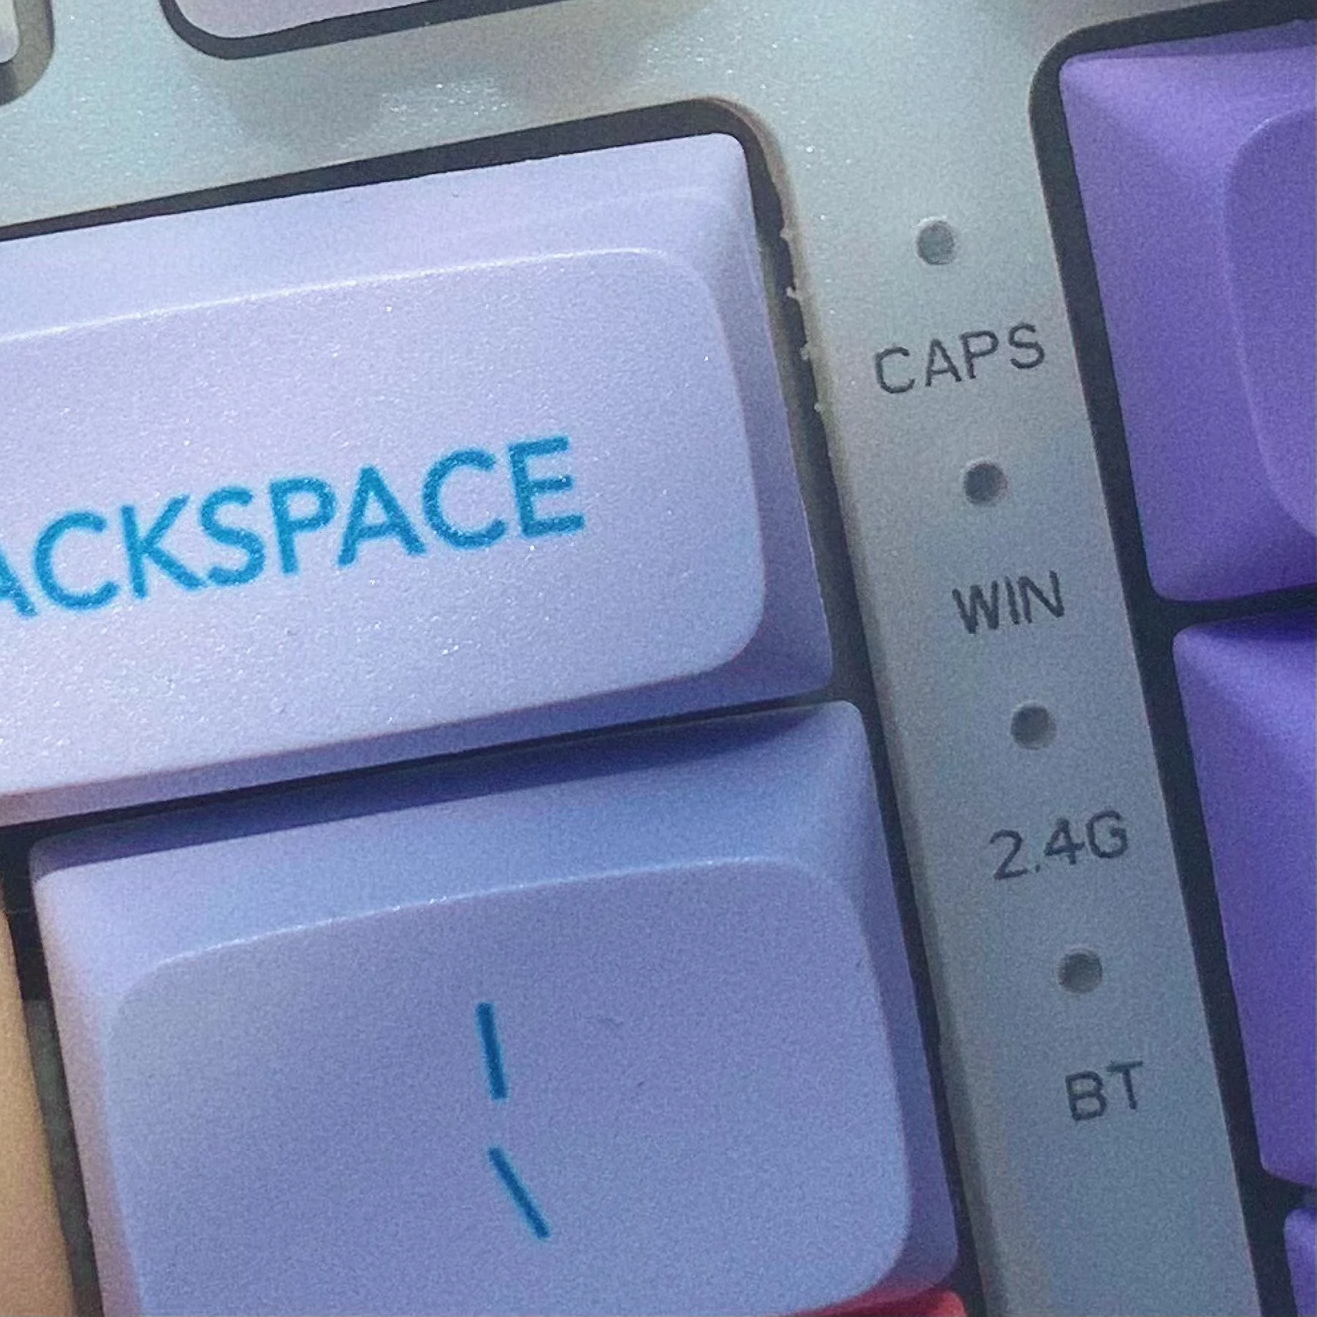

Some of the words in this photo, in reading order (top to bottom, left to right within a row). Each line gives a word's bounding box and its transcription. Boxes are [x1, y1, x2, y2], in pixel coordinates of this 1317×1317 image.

[876, 324, 1044, 394] CAPS
[952, 571, 1064, 633] WIN
[990, 811, 1128, 880] 2.4G
[1066, 1062, 1142, 1121] BT
